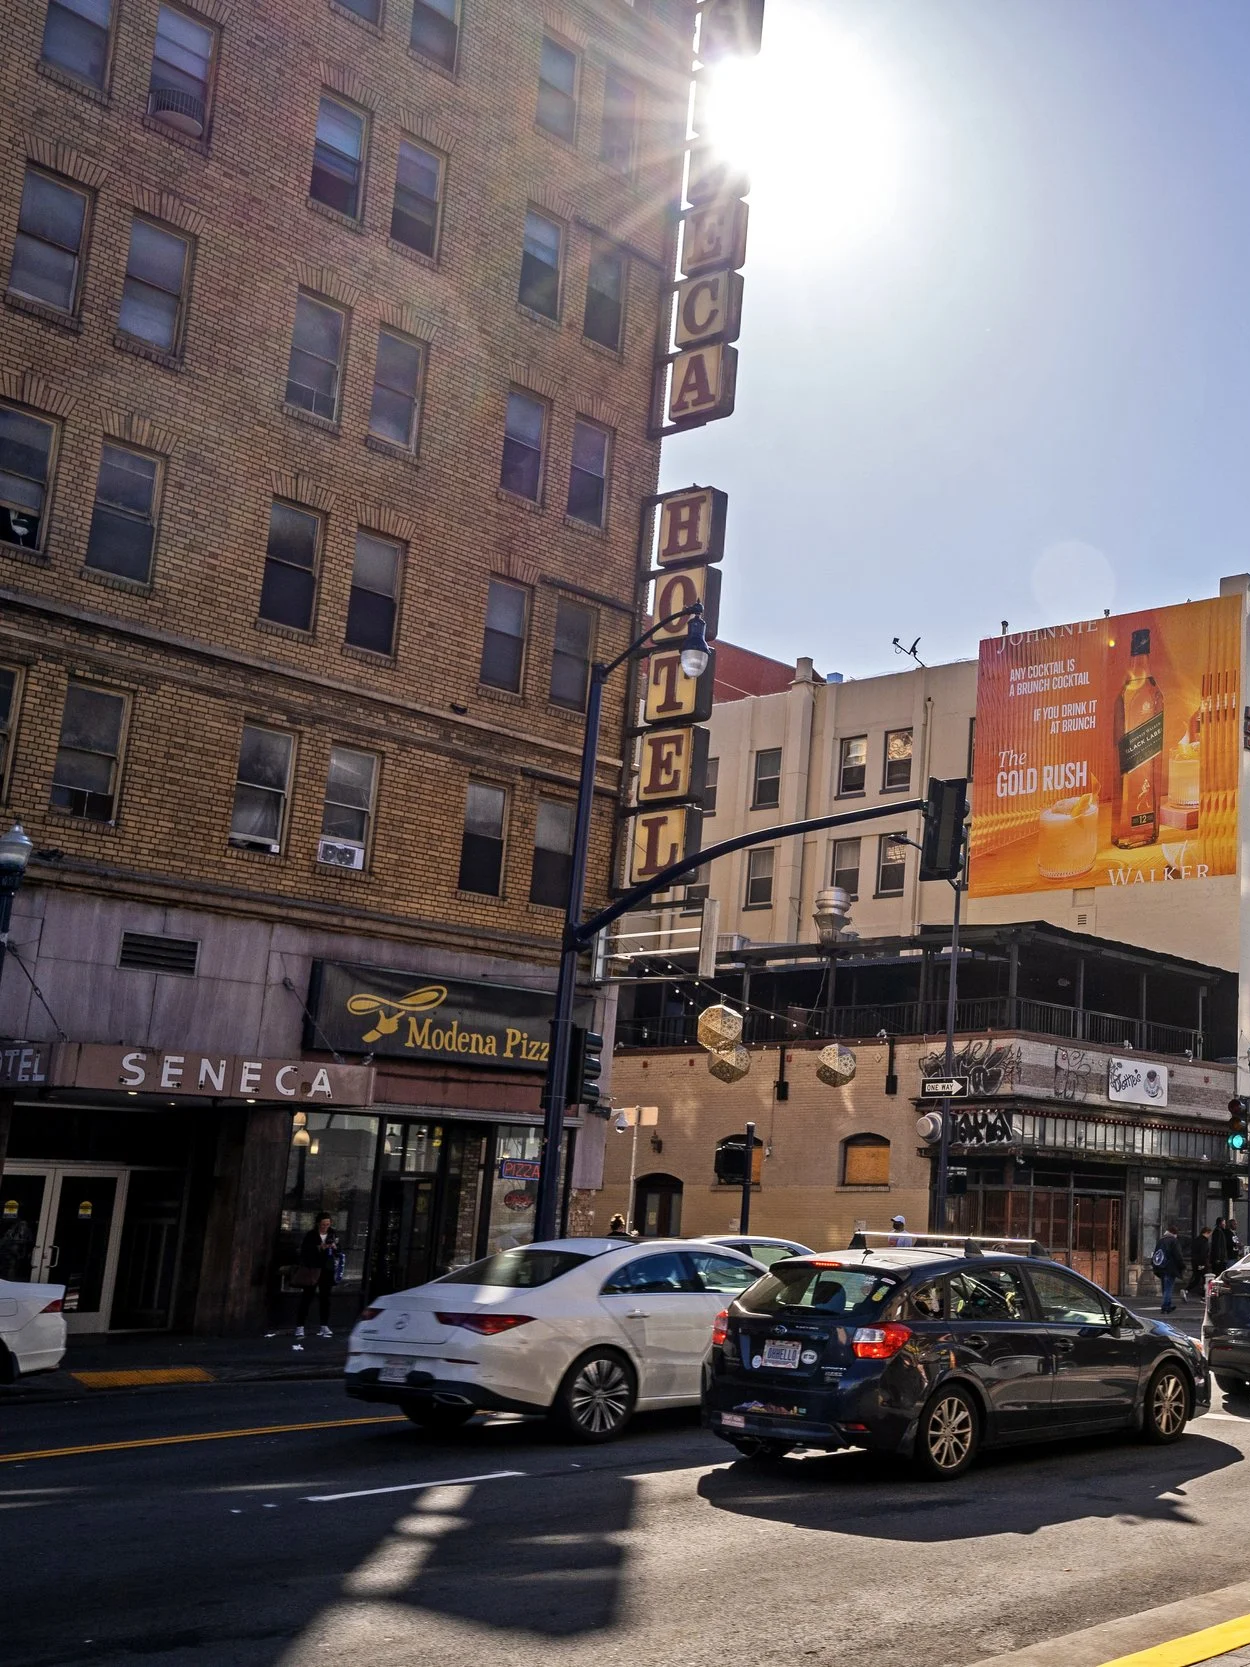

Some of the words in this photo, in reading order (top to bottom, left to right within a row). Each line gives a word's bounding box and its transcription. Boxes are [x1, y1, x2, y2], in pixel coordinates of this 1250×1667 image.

[1010, 666, 1026, 682] ANY
[1027, 661, 1065, 679] COCKTAIL
[1067, 658, 1075, 672] IS
[638, 495, 707, 877] HOTEL
[1009, 683, 1015, 697] A
[1016, 678, 1050, 696] BRUNCH
[1052, 672, 1090, 690] COCKTAIL
[1033, 708, 1041, 722] IF
[1043, 706, 1059, 720] YOU
[1062, 702, 1086, 717] DRINK
[1089, 700, 1097, 713] IT
[1050, 720, 1060, 735] AT
[1062, 715, 1096, 733] BRUNCH
[998, 750, 1027, 768] The
[996, 768, 1038, 798] GOLD
[1042, 760, 1089, 792] RUSH
[1139, 815, 1147, 824] 12
[405, 1017, 498, 1057] Modena
[503, 1028, 550, 1062] Pizz
[0, 1048, 45, 1082] TEL
[119, 1053, 333, 1099] SENECA
[505, 1162, 540, 1178] PIZZA
